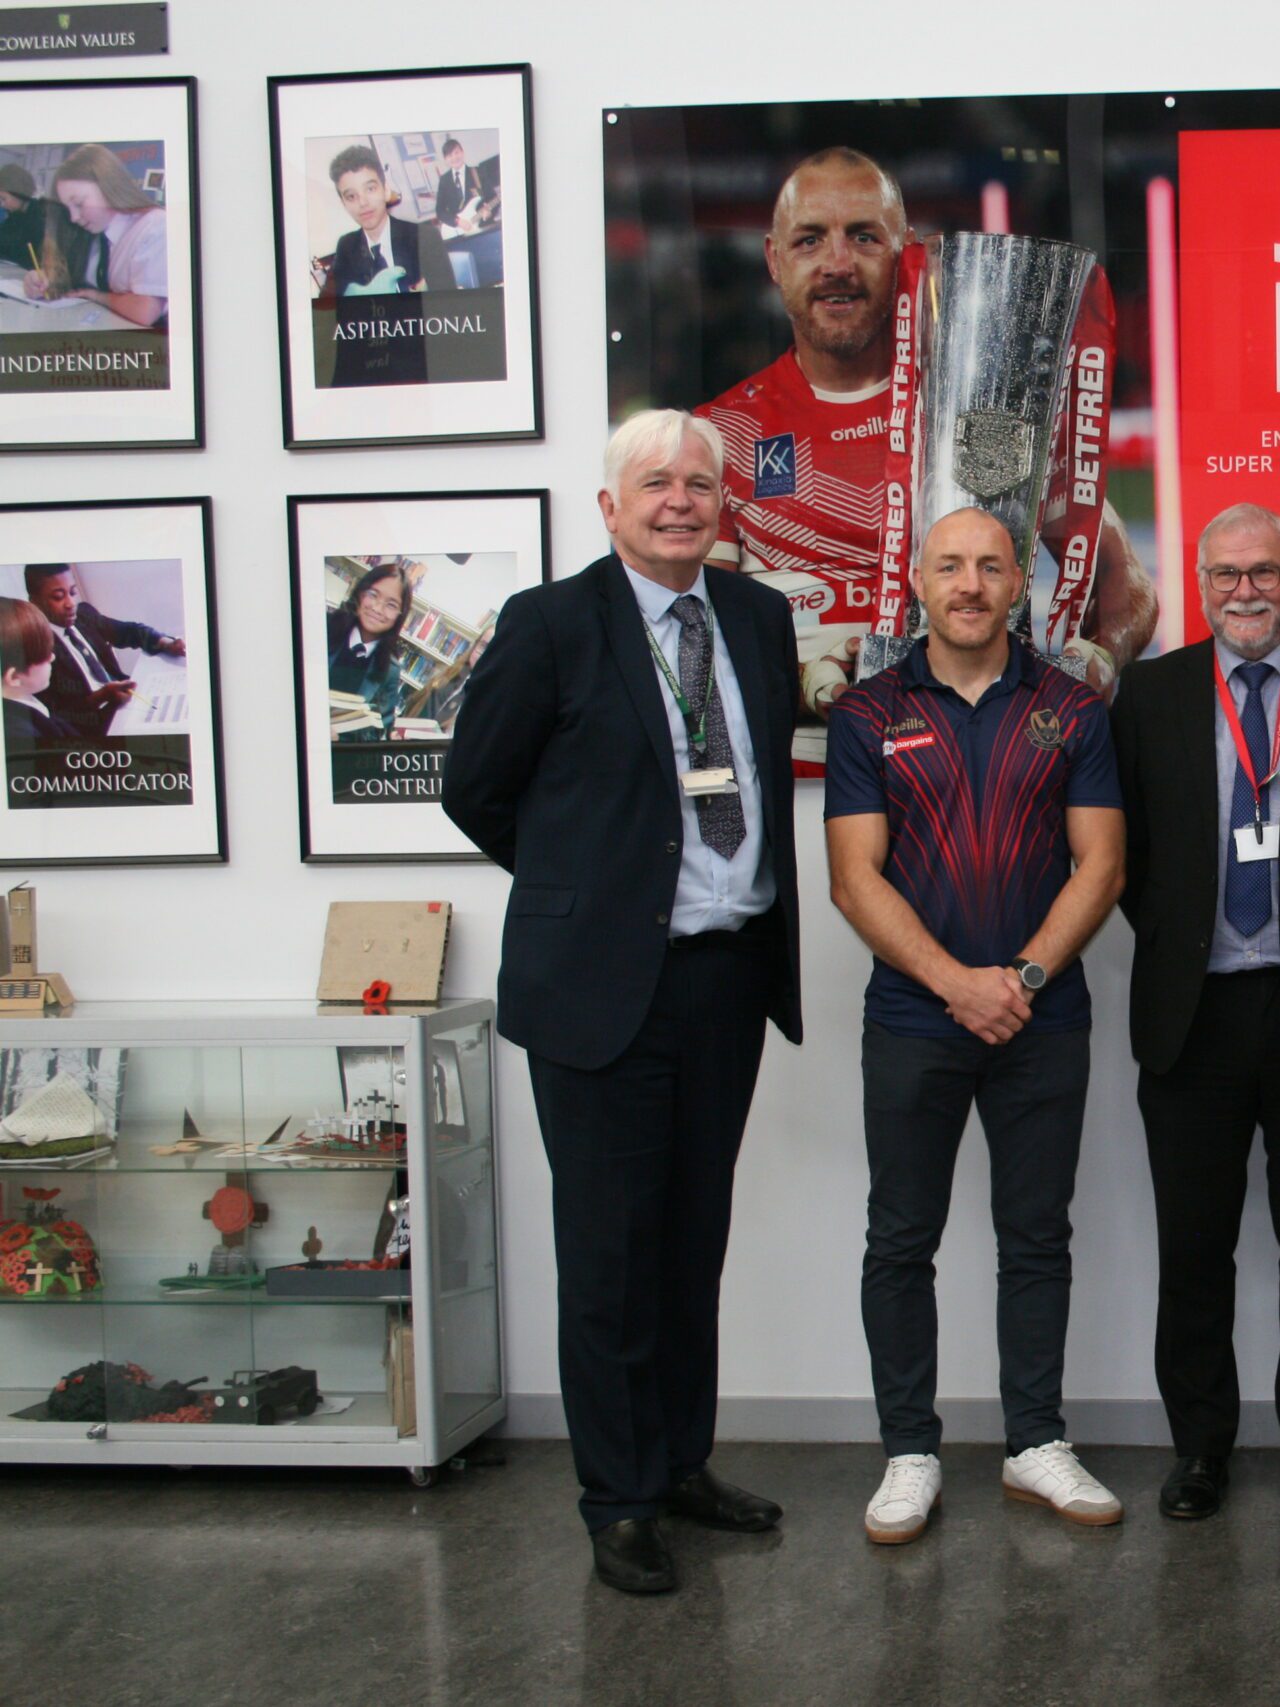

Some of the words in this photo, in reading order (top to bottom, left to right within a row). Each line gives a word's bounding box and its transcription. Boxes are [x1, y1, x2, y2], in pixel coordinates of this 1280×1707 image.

[0, 35, 77, 51] COWLEIAN
[81, 32, 136, 47] VALUES
[333, 315, 487, 341] ASPIRATIONAL
[1, 351, 153, 374] INDEPENDENT
[890, 293, 911, 453] BETFRED
[1073, 346, 1106, 507] BETFRED
[1206, 455, 1273, 473] SUPER
[875, 481, 905, 637] BETFRED
[66, 751, 132, 769] GOOD
[382, 753, 446, 772] POSIT
[11, 773, 192, 794] COMMUNICATOR
[351, 777, 442, 796] CONTRI
